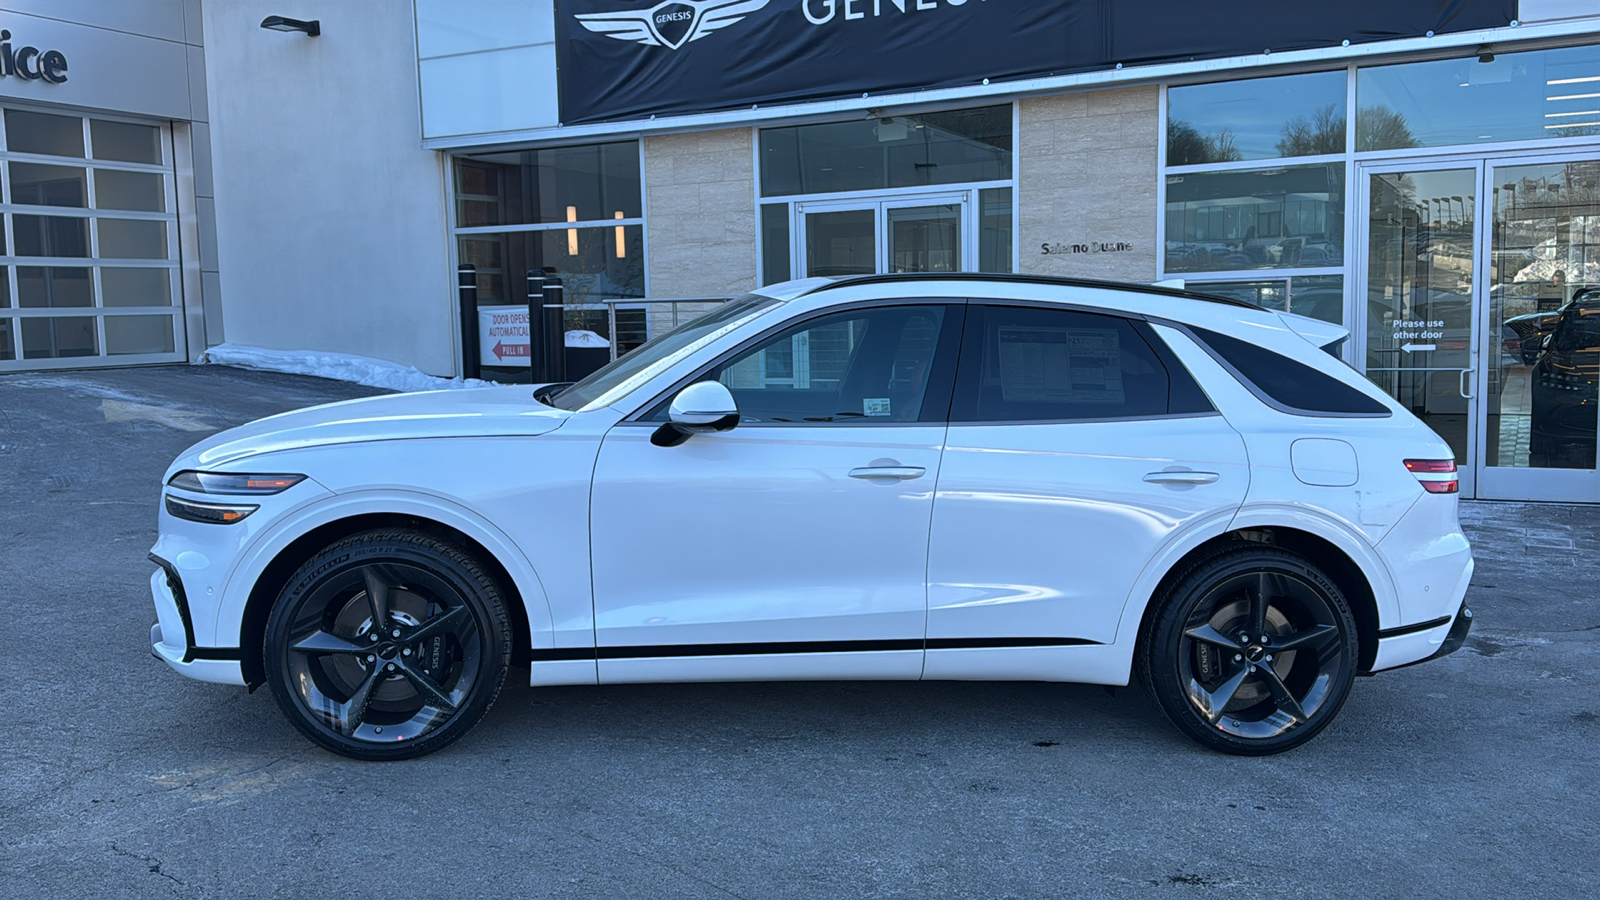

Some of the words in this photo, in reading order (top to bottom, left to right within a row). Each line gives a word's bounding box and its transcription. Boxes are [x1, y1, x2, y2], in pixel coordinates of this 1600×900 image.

[656, 11, 692, 24] GENESIS
[1041, 242, 1089, 255] Salerno
[1092, 241, 1134, 253] Duane
[493, 314, 509, 325] DOOR
[510, 313, 530, 324] OPENS
[1393, 319, 1425, 328] Please
[1427, 320, 1444, 328] use
[1393, 330, 1419, 339] other
[1421, 330, 1443, 339] door
[502, 346, 516, 355] PULL
[517, 346, 524, 355] IN
[302, 554, 349, 586] MICHELIN
[1316, 576, 1347, 613] MICHELIN
[432, 636, 441, 669] GENESIS
[1200, 643, 1209, 674] GENESIS
